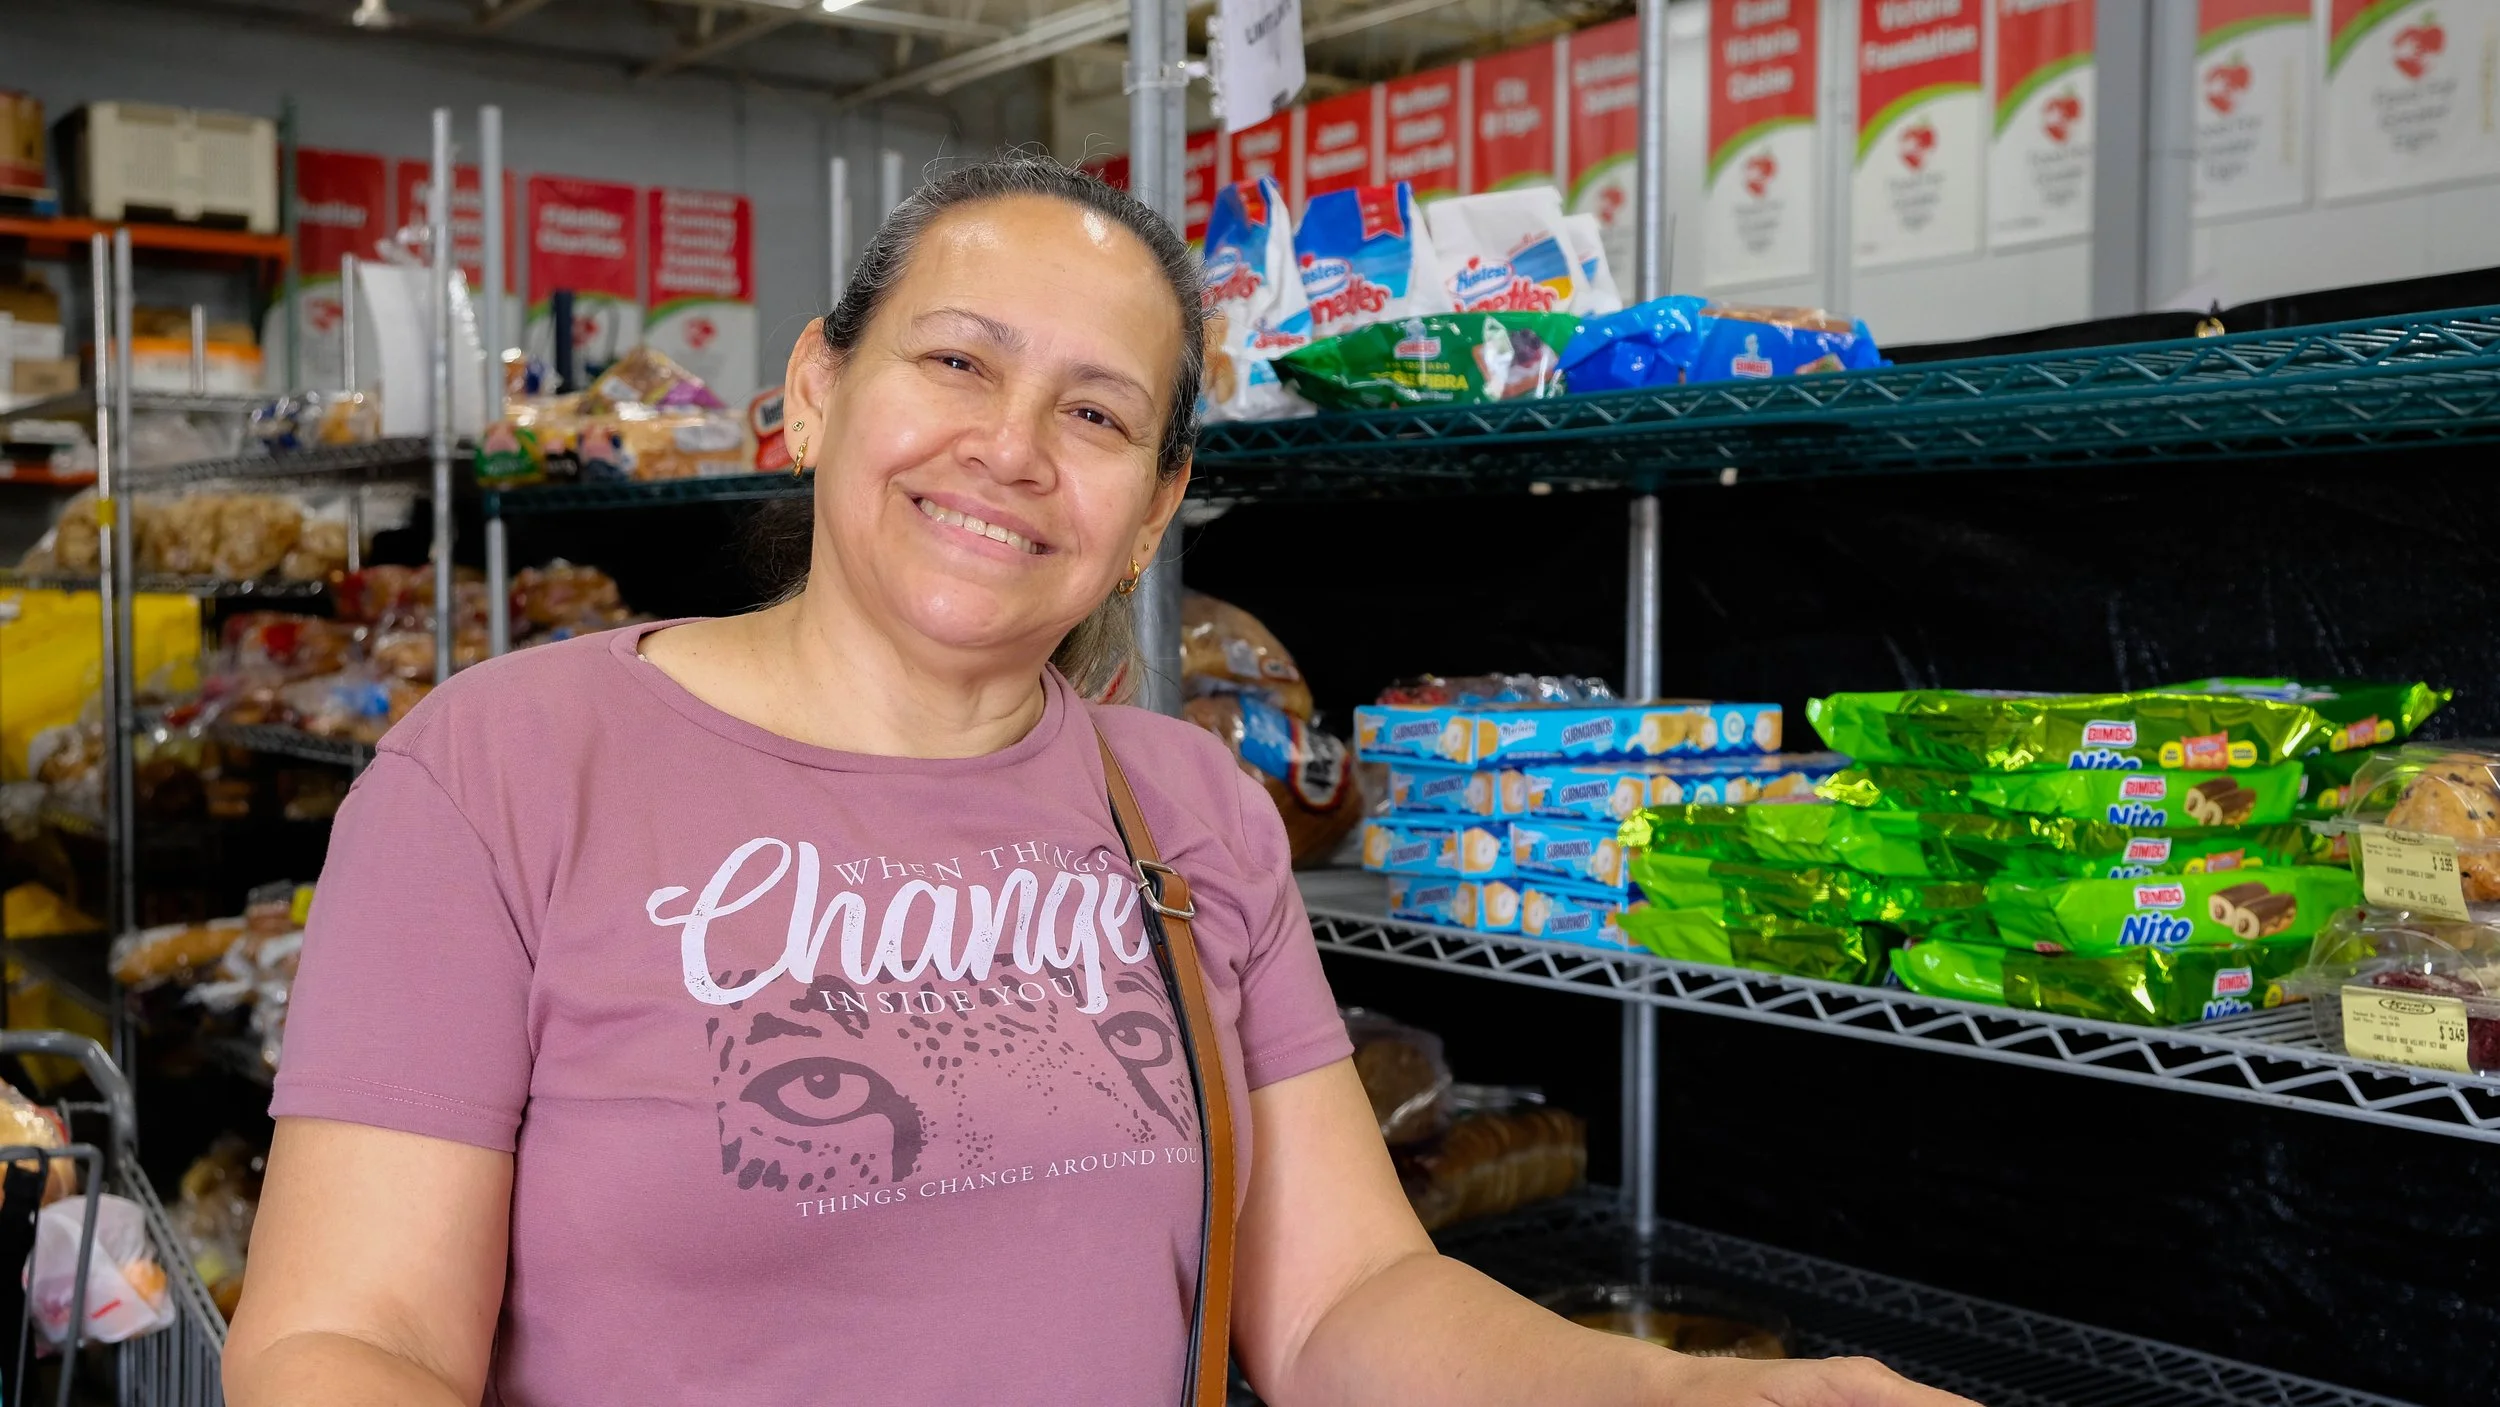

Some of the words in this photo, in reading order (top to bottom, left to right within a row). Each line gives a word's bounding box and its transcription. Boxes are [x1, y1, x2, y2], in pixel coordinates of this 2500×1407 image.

[1311, 276, 1393, 326] nettes
[2087, 726, 2134, 742] BIMBO
[2125, 780, 2165, 796] BIMBO
[834, 856, 965, 887] WHEN
[980, 840, 1112, 874] THINGS
[2138, 889, 2183, 905] BIMBO
[646, 836, 1151, 1015] Change
[2119, 913, 2191, 946] Nito
[820, 989, 978, 1016] INSIDE
[983, 974, 1077, 1008] YOU
[2449, 1027, 2465, 1042] 3.49
[796, 1184, 908, 1218] THINGS
[919, 1164, 1036, 1199] CHANGE
[1044, 1147, 1157, 1178] AROUND
